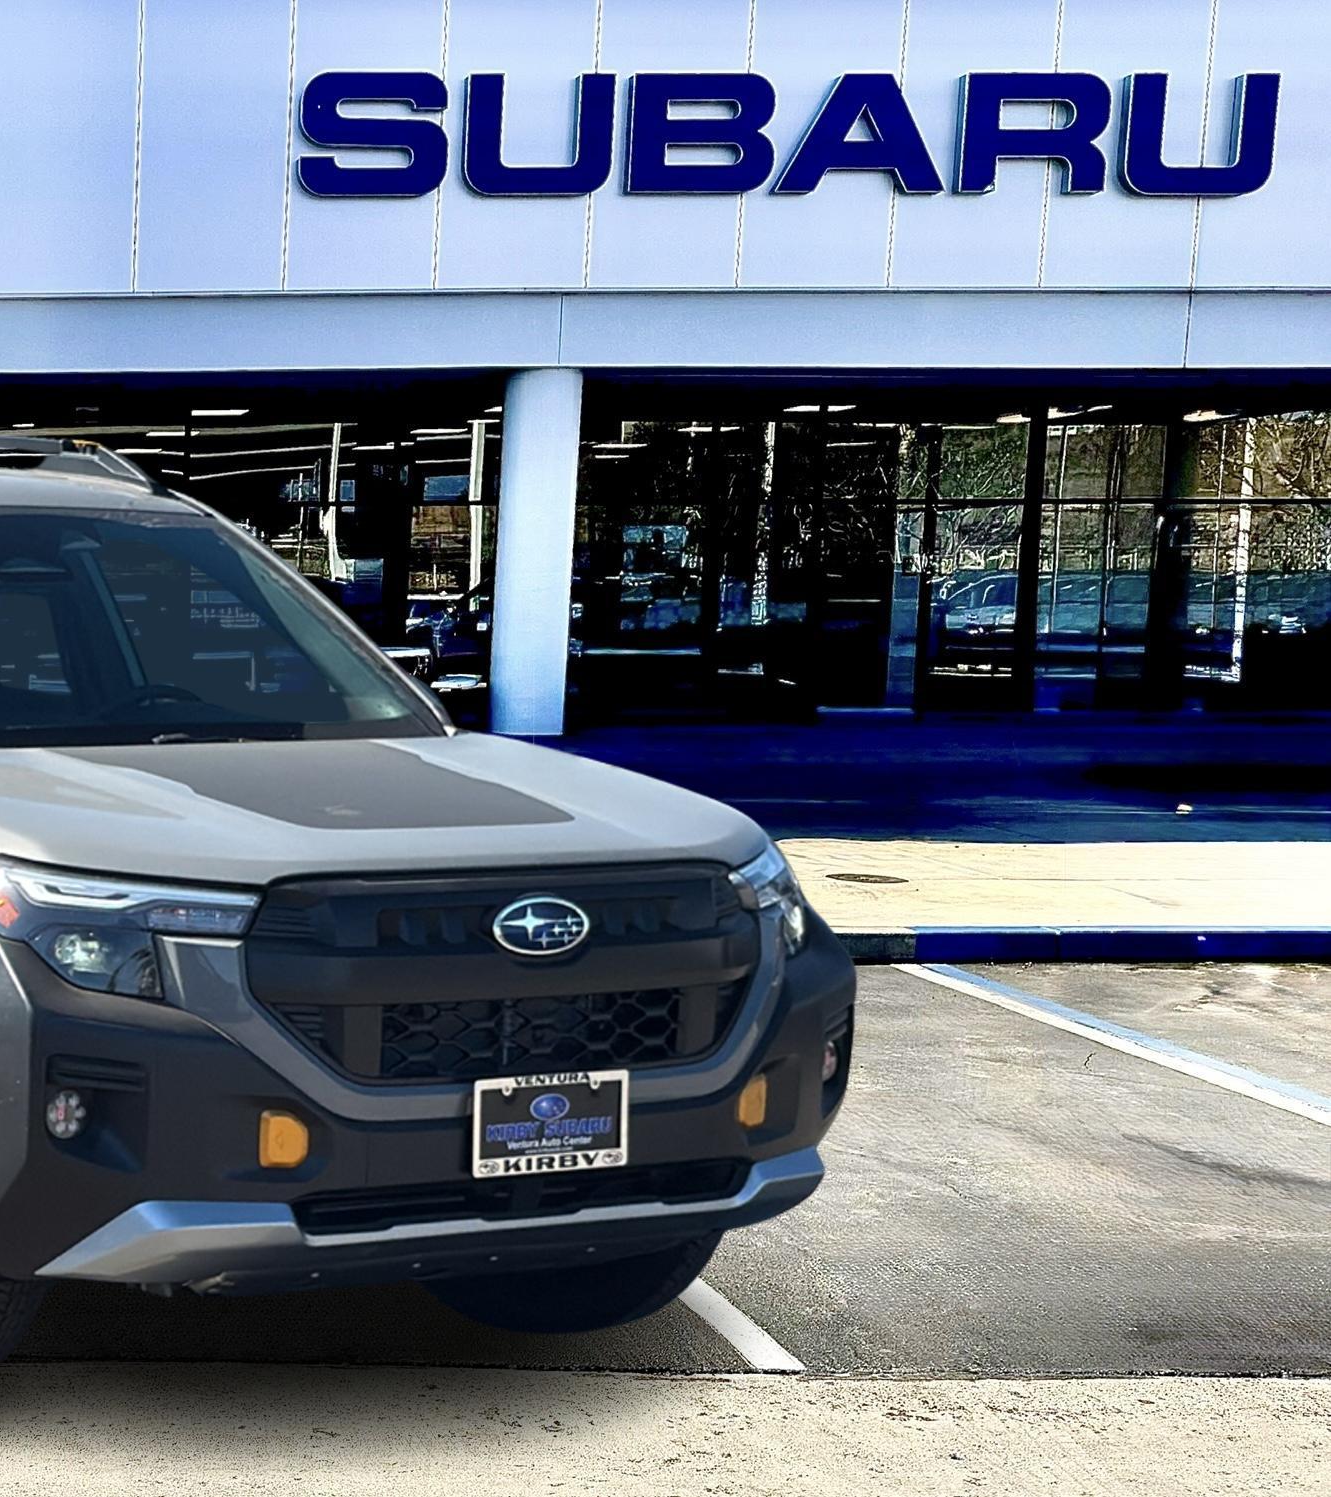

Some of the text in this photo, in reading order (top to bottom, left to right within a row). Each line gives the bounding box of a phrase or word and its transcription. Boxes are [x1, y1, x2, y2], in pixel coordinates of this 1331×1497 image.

[296, 70, 1281, 197] SUBARU
[514, 1071, 590, 1087] VENTURA
[486, 1116, 613, 1142] KIRBY SUBARU
[506, 1138, 540, 1150] Ventura
[541, 1137, 562, 1147] Auto
[562, 1136, 592, 1145] Center
[503, 1152, 600, 1172] KIRBY
